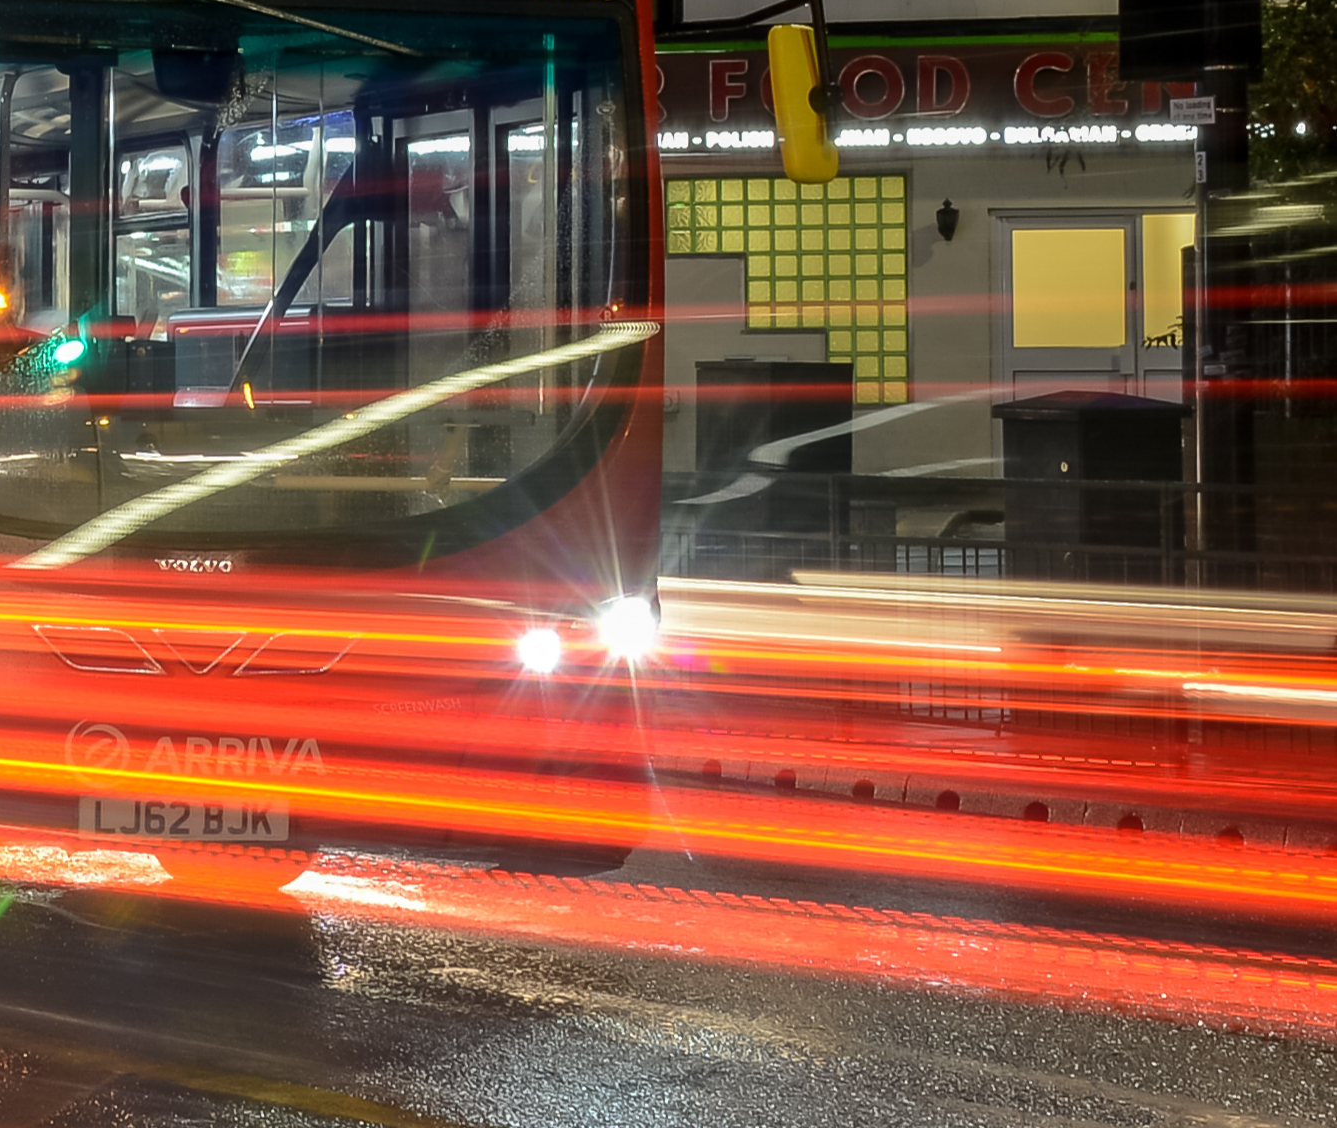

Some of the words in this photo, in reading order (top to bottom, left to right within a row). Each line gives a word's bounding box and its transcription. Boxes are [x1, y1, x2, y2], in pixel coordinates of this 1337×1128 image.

[709, 54, 971, 122] FOD
[1173, 102, 1183, 110] No
[1186, 101, 1211, 110] loading
[1197, 111, 1213, 120] time
[154, 557, 233, 574] VOLVO
[372, 698, 462, 716] SCREENWASH
[144, 737, 326, 777] ARRIVA
[94, 801, 190, 836] LJ62
[203, 801, 272, 836] BJK
